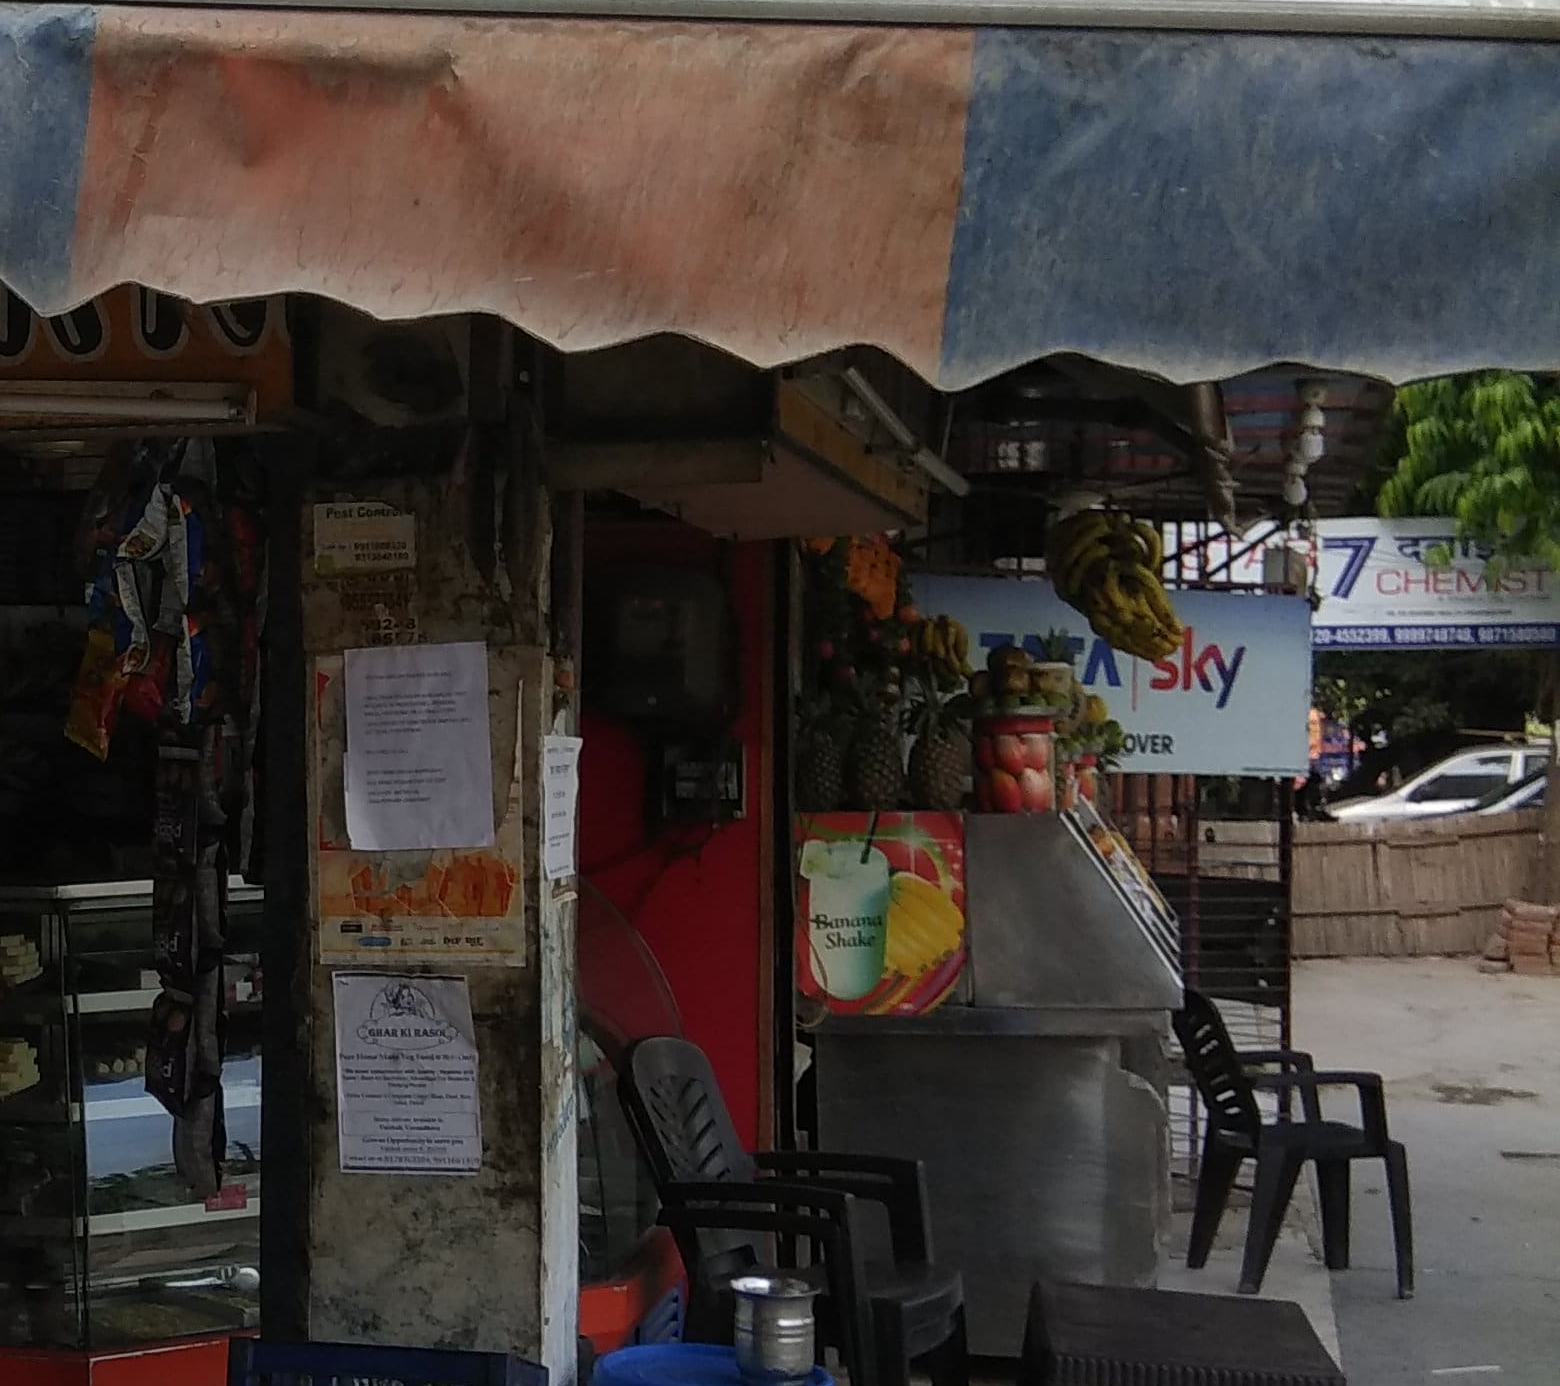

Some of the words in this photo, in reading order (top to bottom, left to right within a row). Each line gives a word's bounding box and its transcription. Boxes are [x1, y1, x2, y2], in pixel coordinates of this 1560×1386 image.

[326, 506, 353, 519] Pest
[1321, 536, 1378, 600] 7
[1376, 567, 1552, 595] CHEMST
[1149, 625, 1247, 710] sky
[814, 913, 883, 931] Banana
[824, 931, 877, 950] Shake
